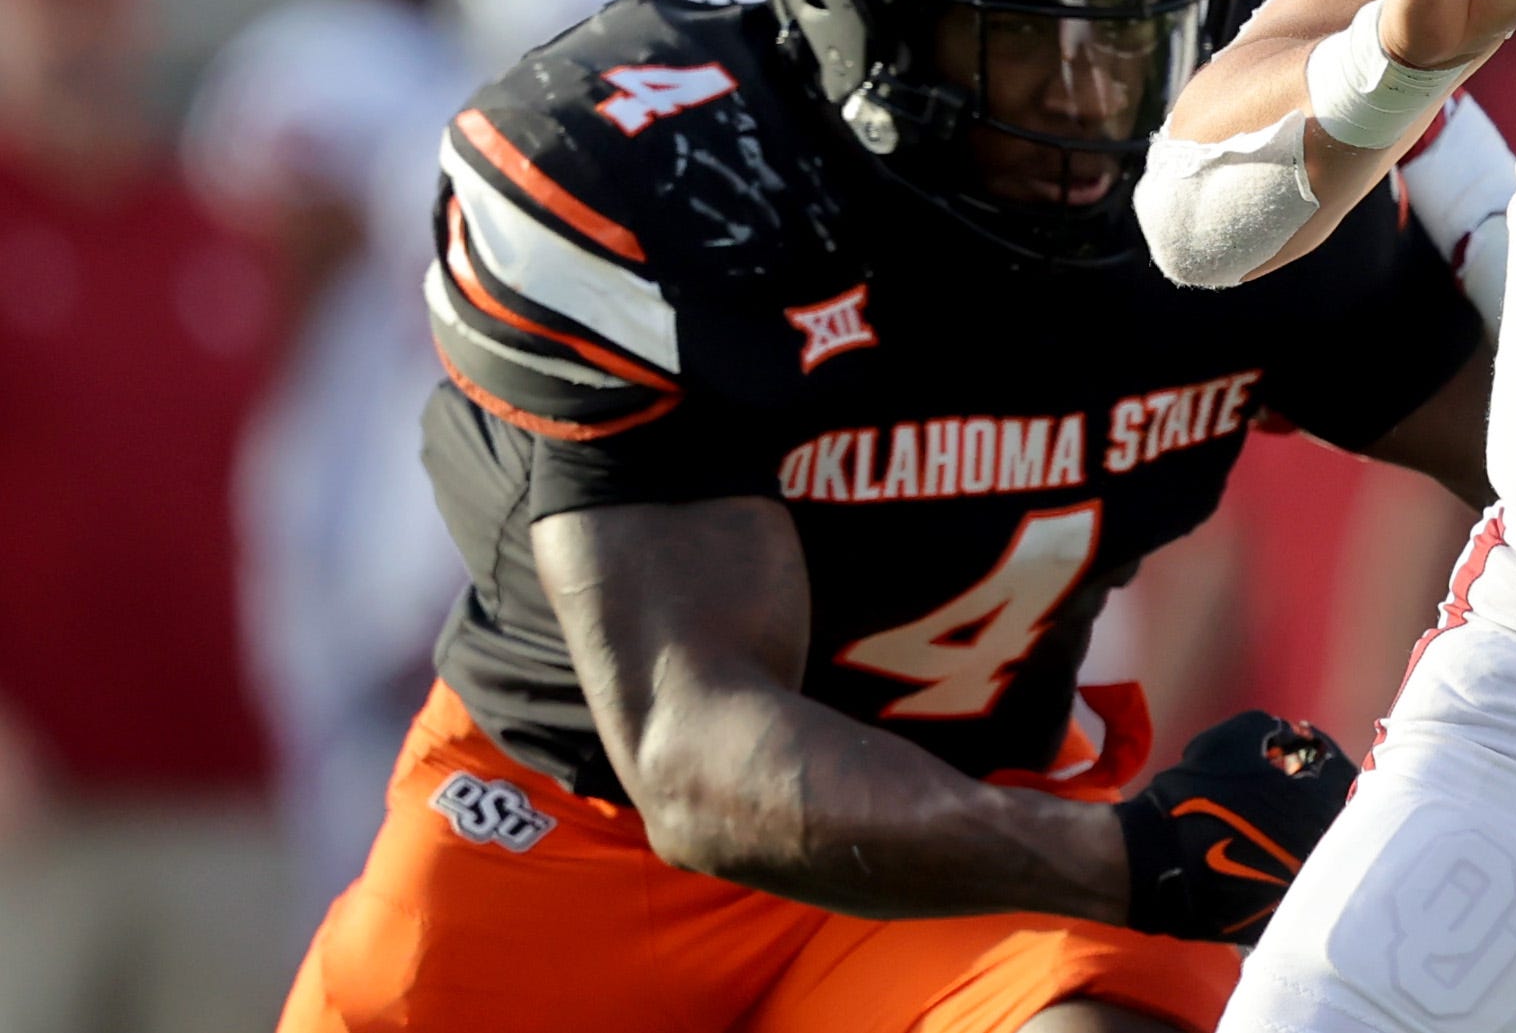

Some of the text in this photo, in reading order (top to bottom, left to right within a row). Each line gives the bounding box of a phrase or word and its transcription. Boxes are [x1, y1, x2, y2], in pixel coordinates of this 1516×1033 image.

[595, 60, 741, 138] 4
[784, 283, 880, 375] XII
[779, 370, 1263, 504] OKLAHOMA STATE
[834, 499, 1104, 721] 4
[431, 772, 556, 849] OSU
